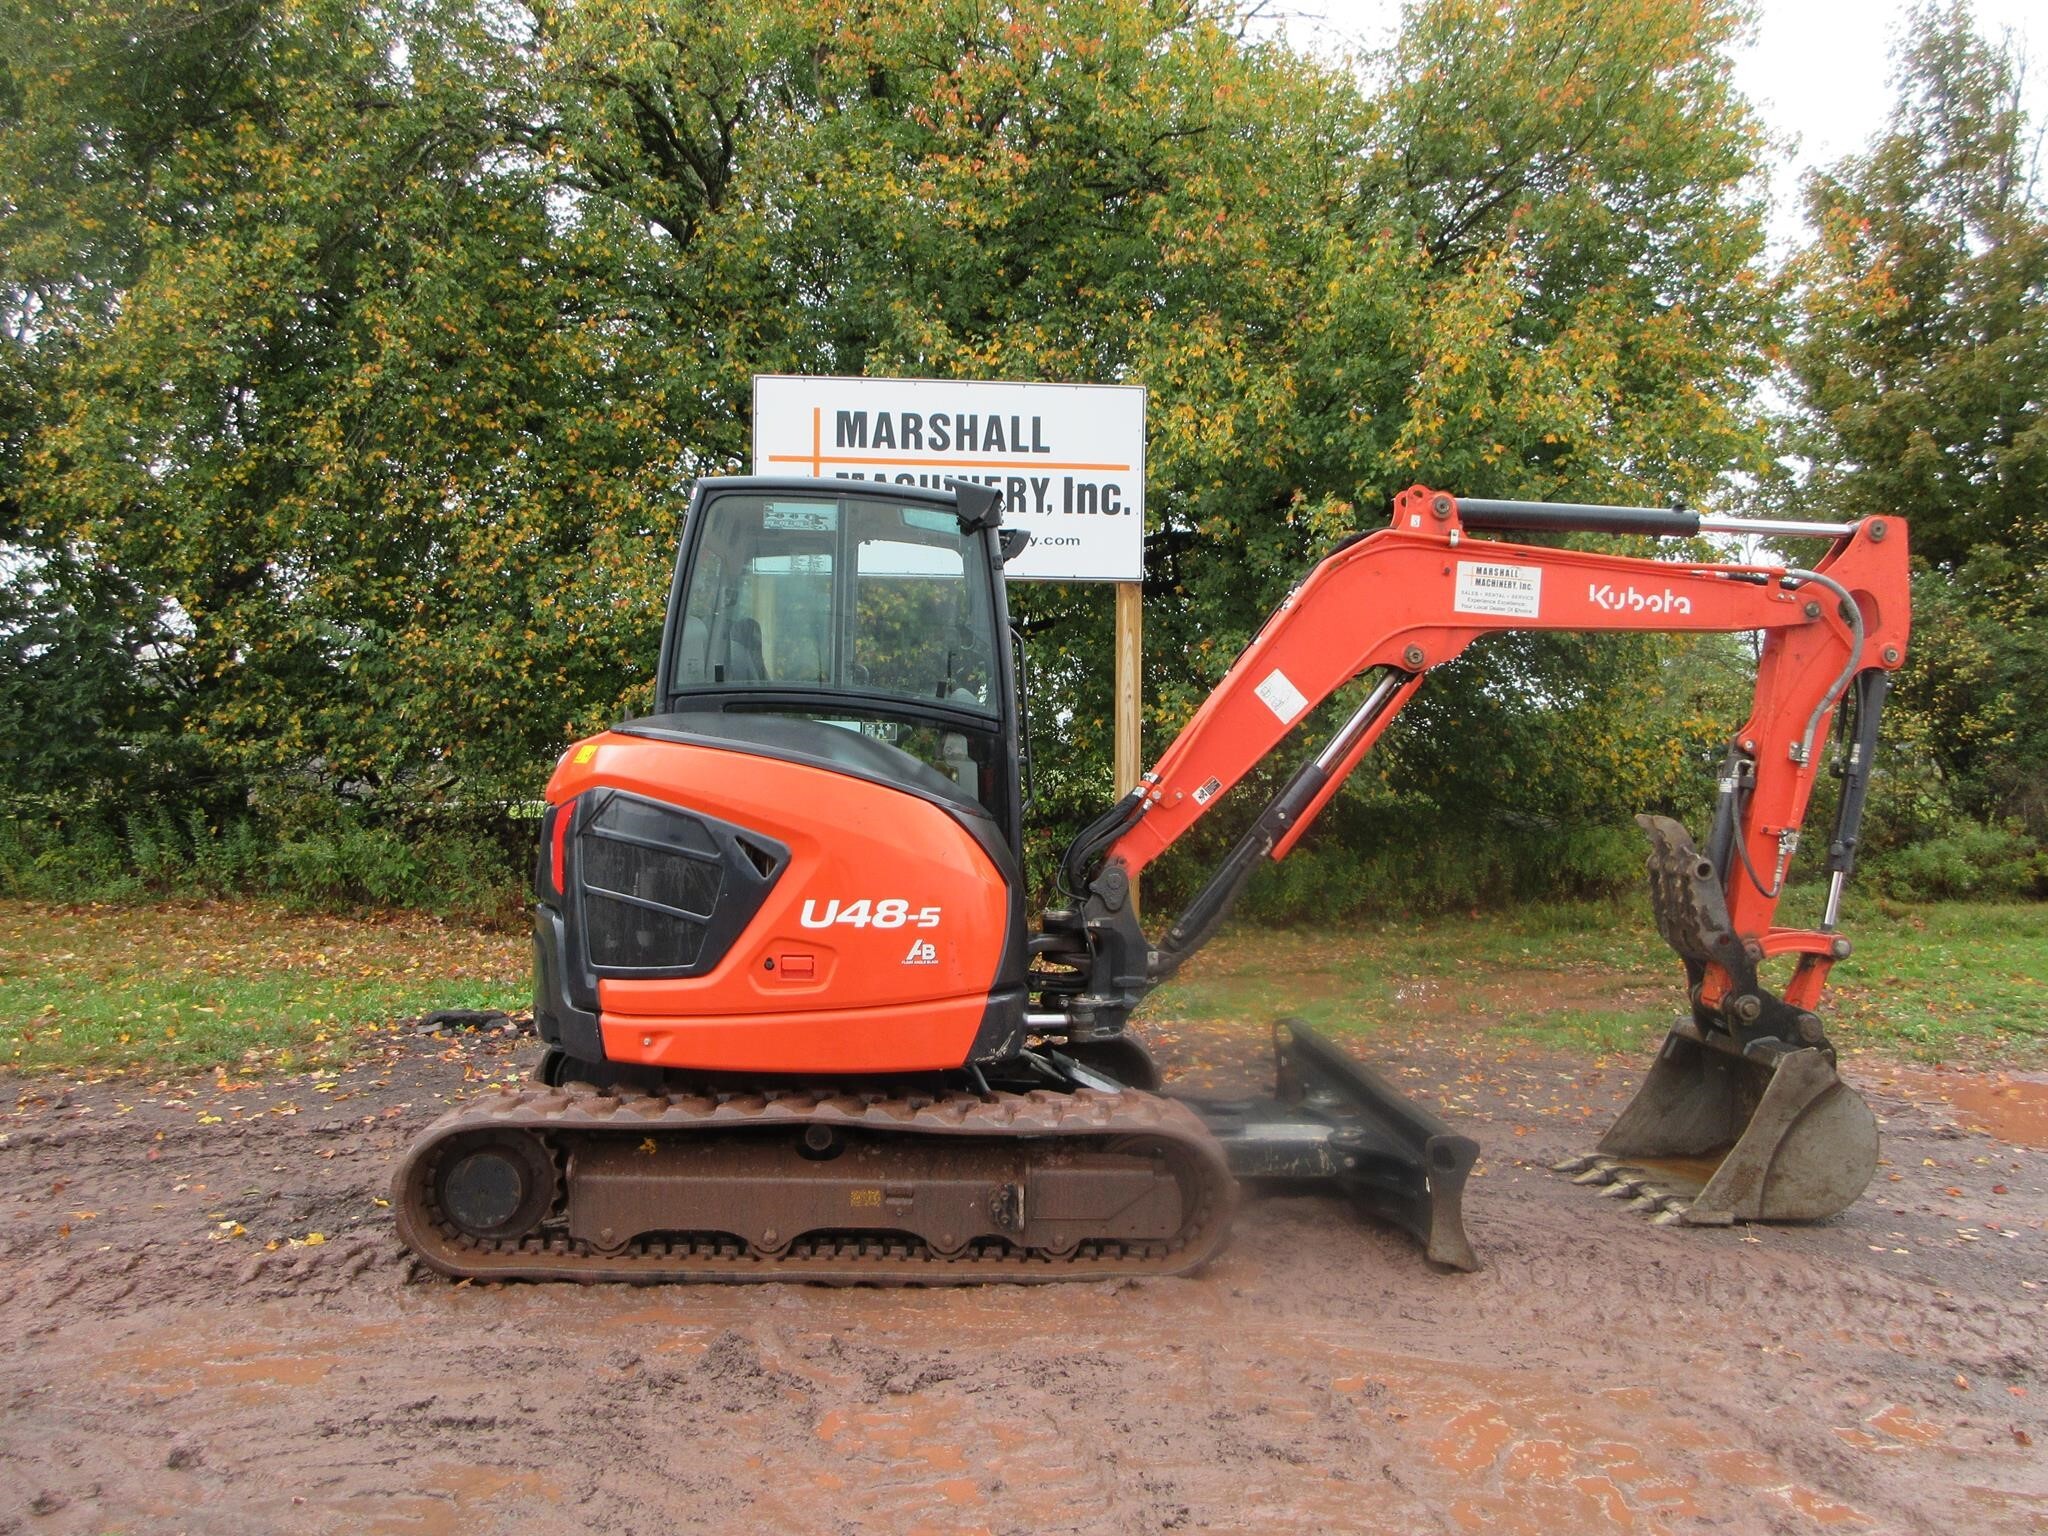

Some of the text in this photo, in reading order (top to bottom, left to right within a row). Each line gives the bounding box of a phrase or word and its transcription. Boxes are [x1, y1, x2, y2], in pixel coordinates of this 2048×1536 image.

[836, 410, 1050, 453] MARSHALL
[1063, 476, 1130, 516] Inc.
[1475, 566, 1518, 577] MARSHALL
[1519, 582, 1533, 590] Inc.
[1589, 584, 1691, 614] Kubota
[800, 899, 941, 928] U48-5
[906, 939, 936, 960] AB
